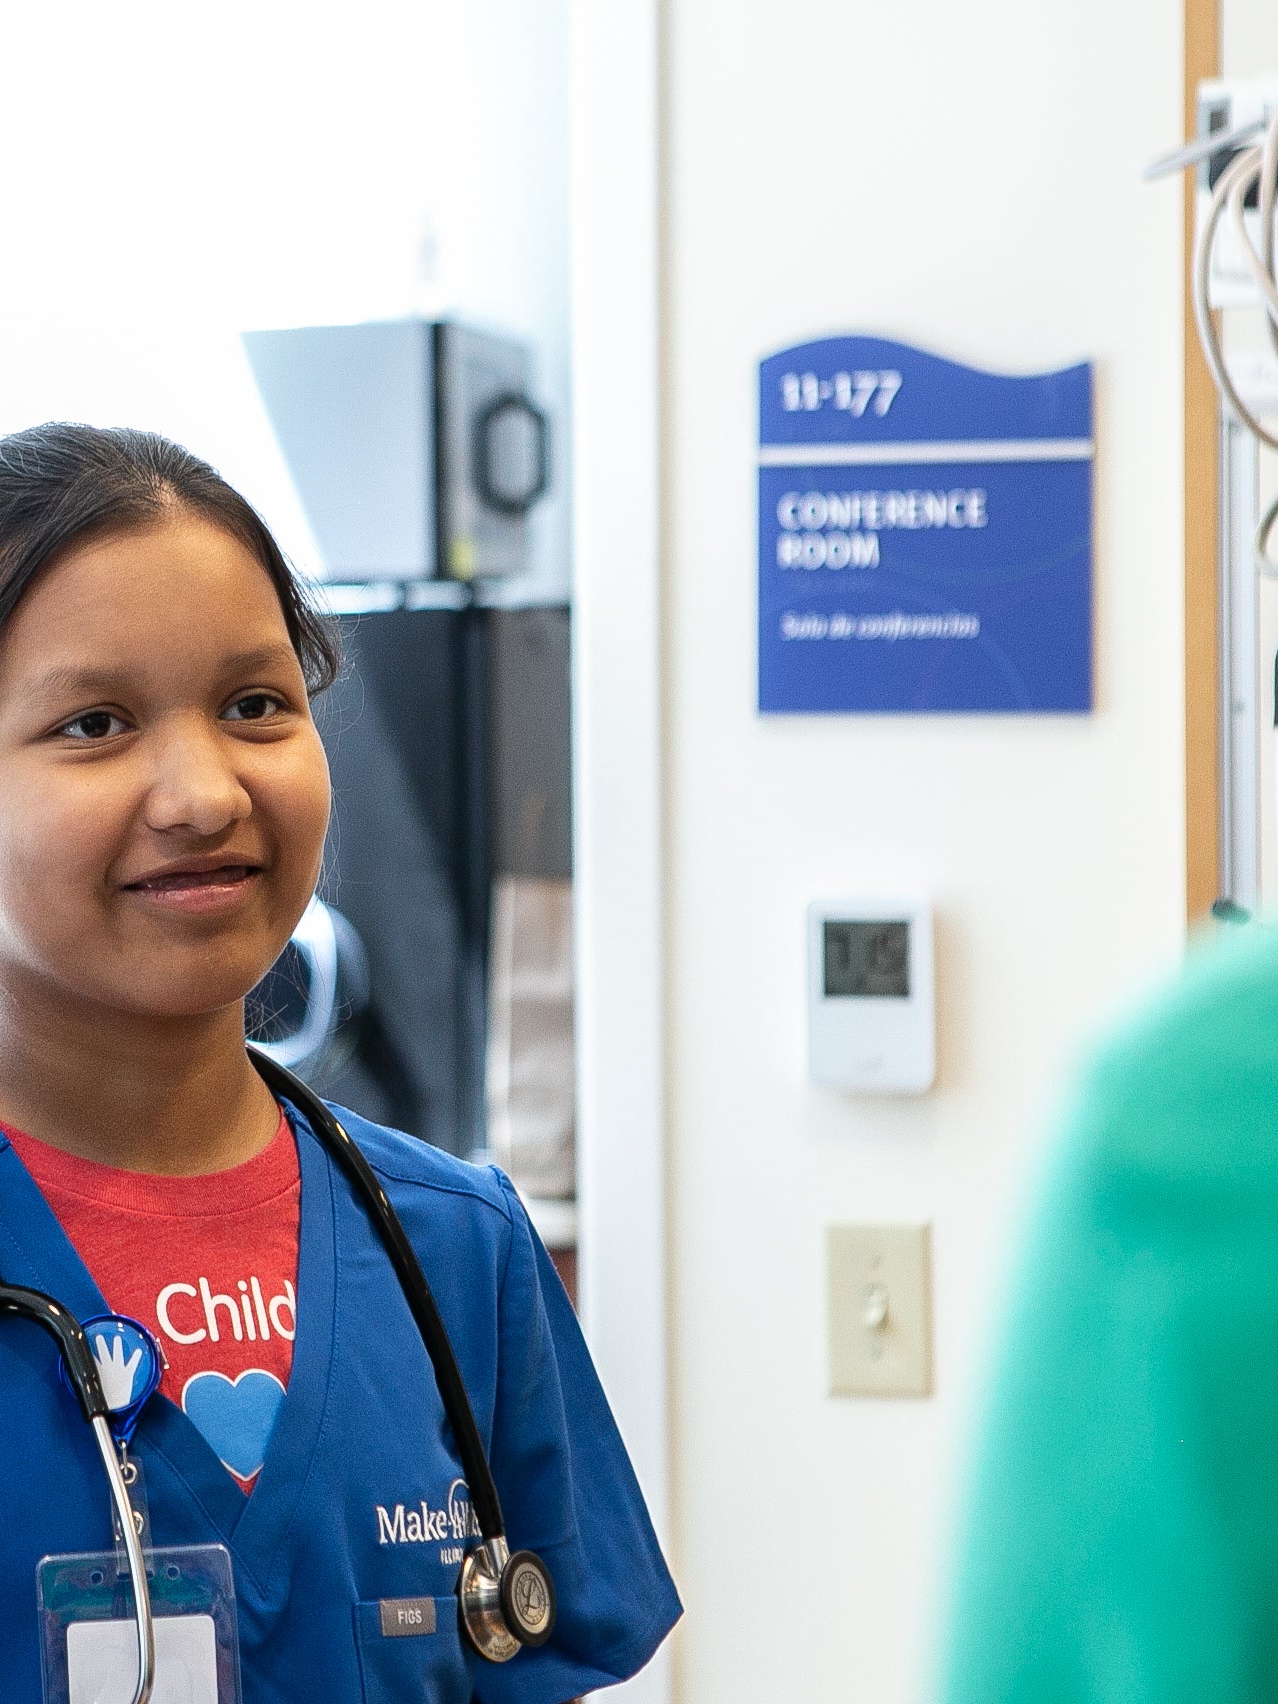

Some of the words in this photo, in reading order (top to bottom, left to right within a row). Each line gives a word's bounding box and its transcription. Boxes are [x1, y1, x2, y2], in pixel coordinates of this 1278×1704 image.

[782, 370, 903, 418] 11-177
[777, 488, 988, 531] CONFERENCE
[777, 531, 880, 570] ROOM
[156, 1276, 296, 1345] Child
[397, 1609, 422, 1625] FIGS
